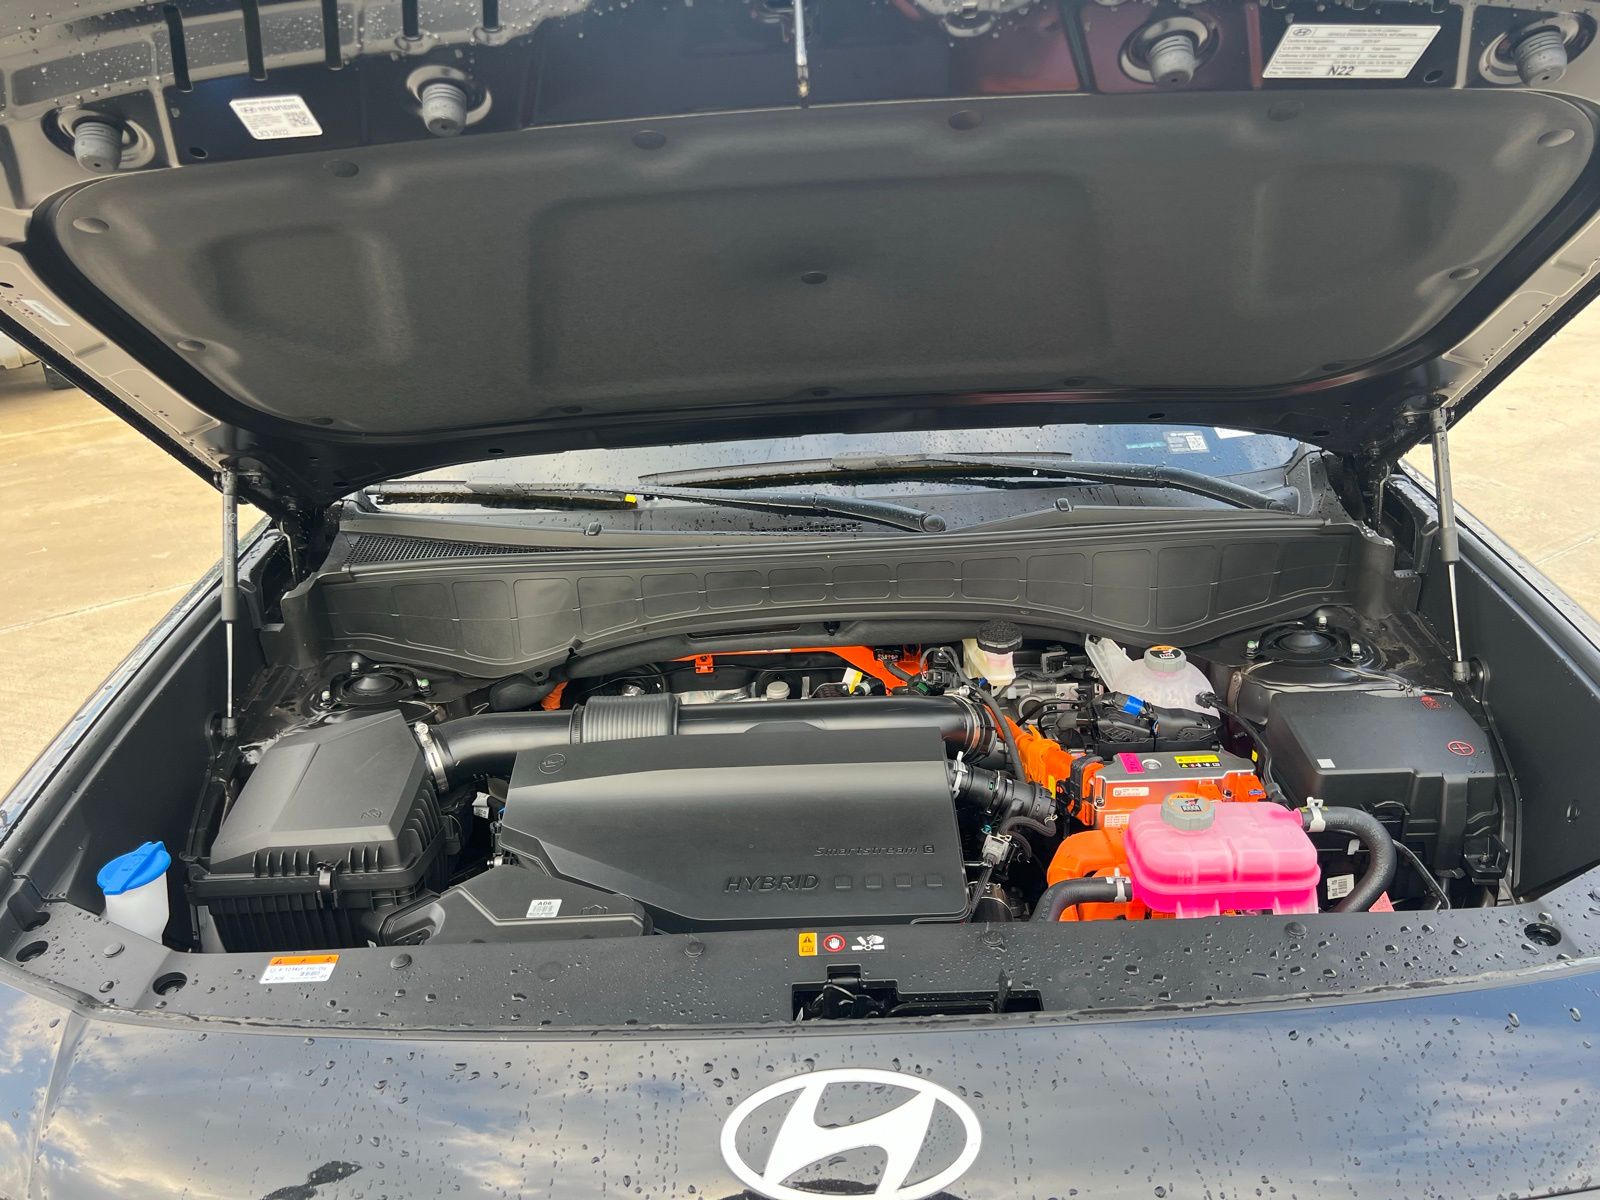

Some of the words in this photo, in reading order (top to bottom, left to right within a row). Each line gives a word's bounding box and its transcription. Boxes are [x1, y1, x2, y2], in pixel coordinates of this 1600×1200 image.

[1327, 65, 1355, 76] N22
[813, 846, 918, 857] Smartstream
[724, 874, 820, 893] HYBRID
